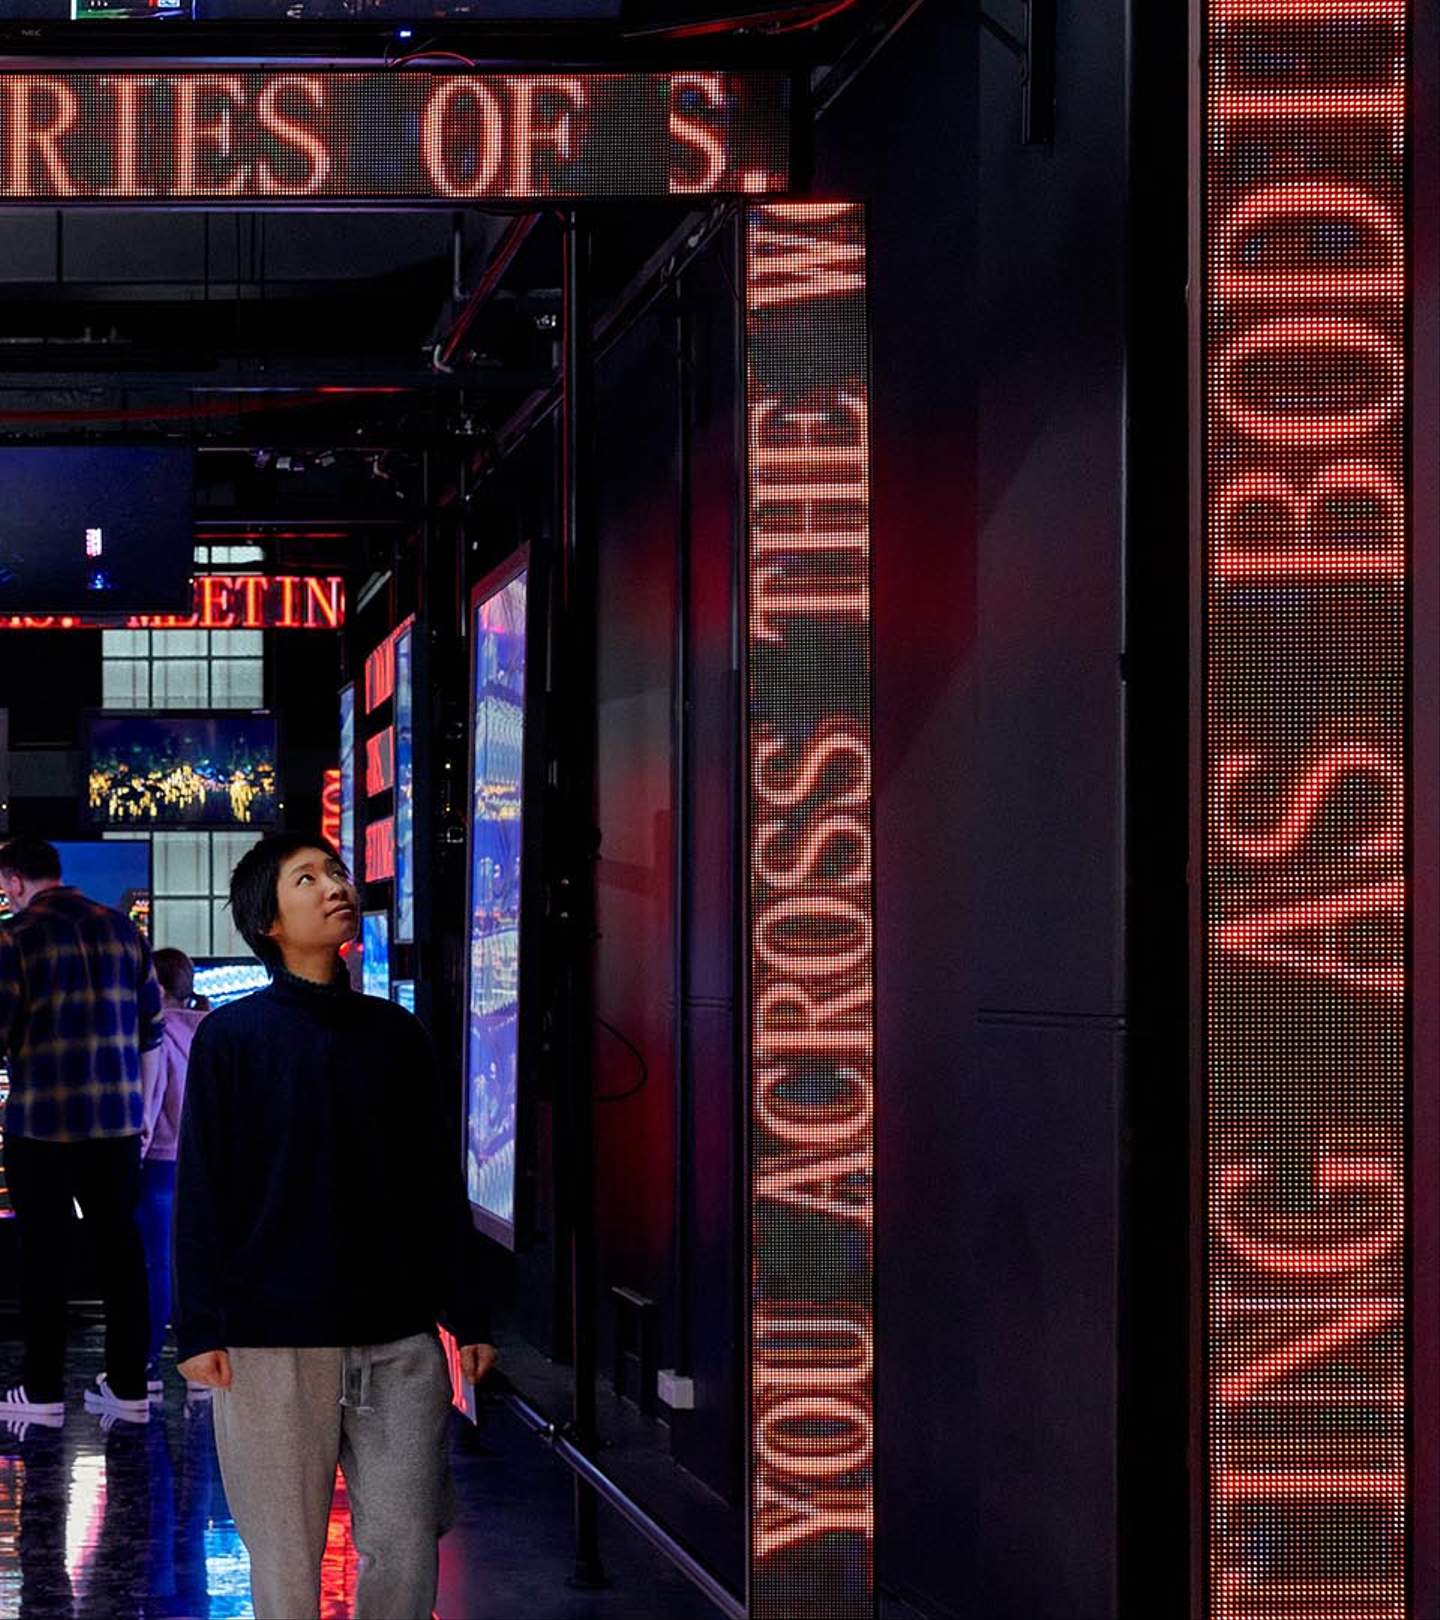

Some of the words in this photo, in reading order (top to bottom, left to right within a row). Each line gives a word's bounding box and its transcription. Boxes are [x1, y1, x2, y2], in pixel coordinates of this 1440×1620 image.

[420, 73, 588, 197] OF
[1210, 0, 1405, 586] BODI
[747, 393, 871, 642] THE
[751, 731, 873, 1227] ACROSS
[1211, 746, 1404, 998] AS
[752, 1316, 874, 1560] YOU
